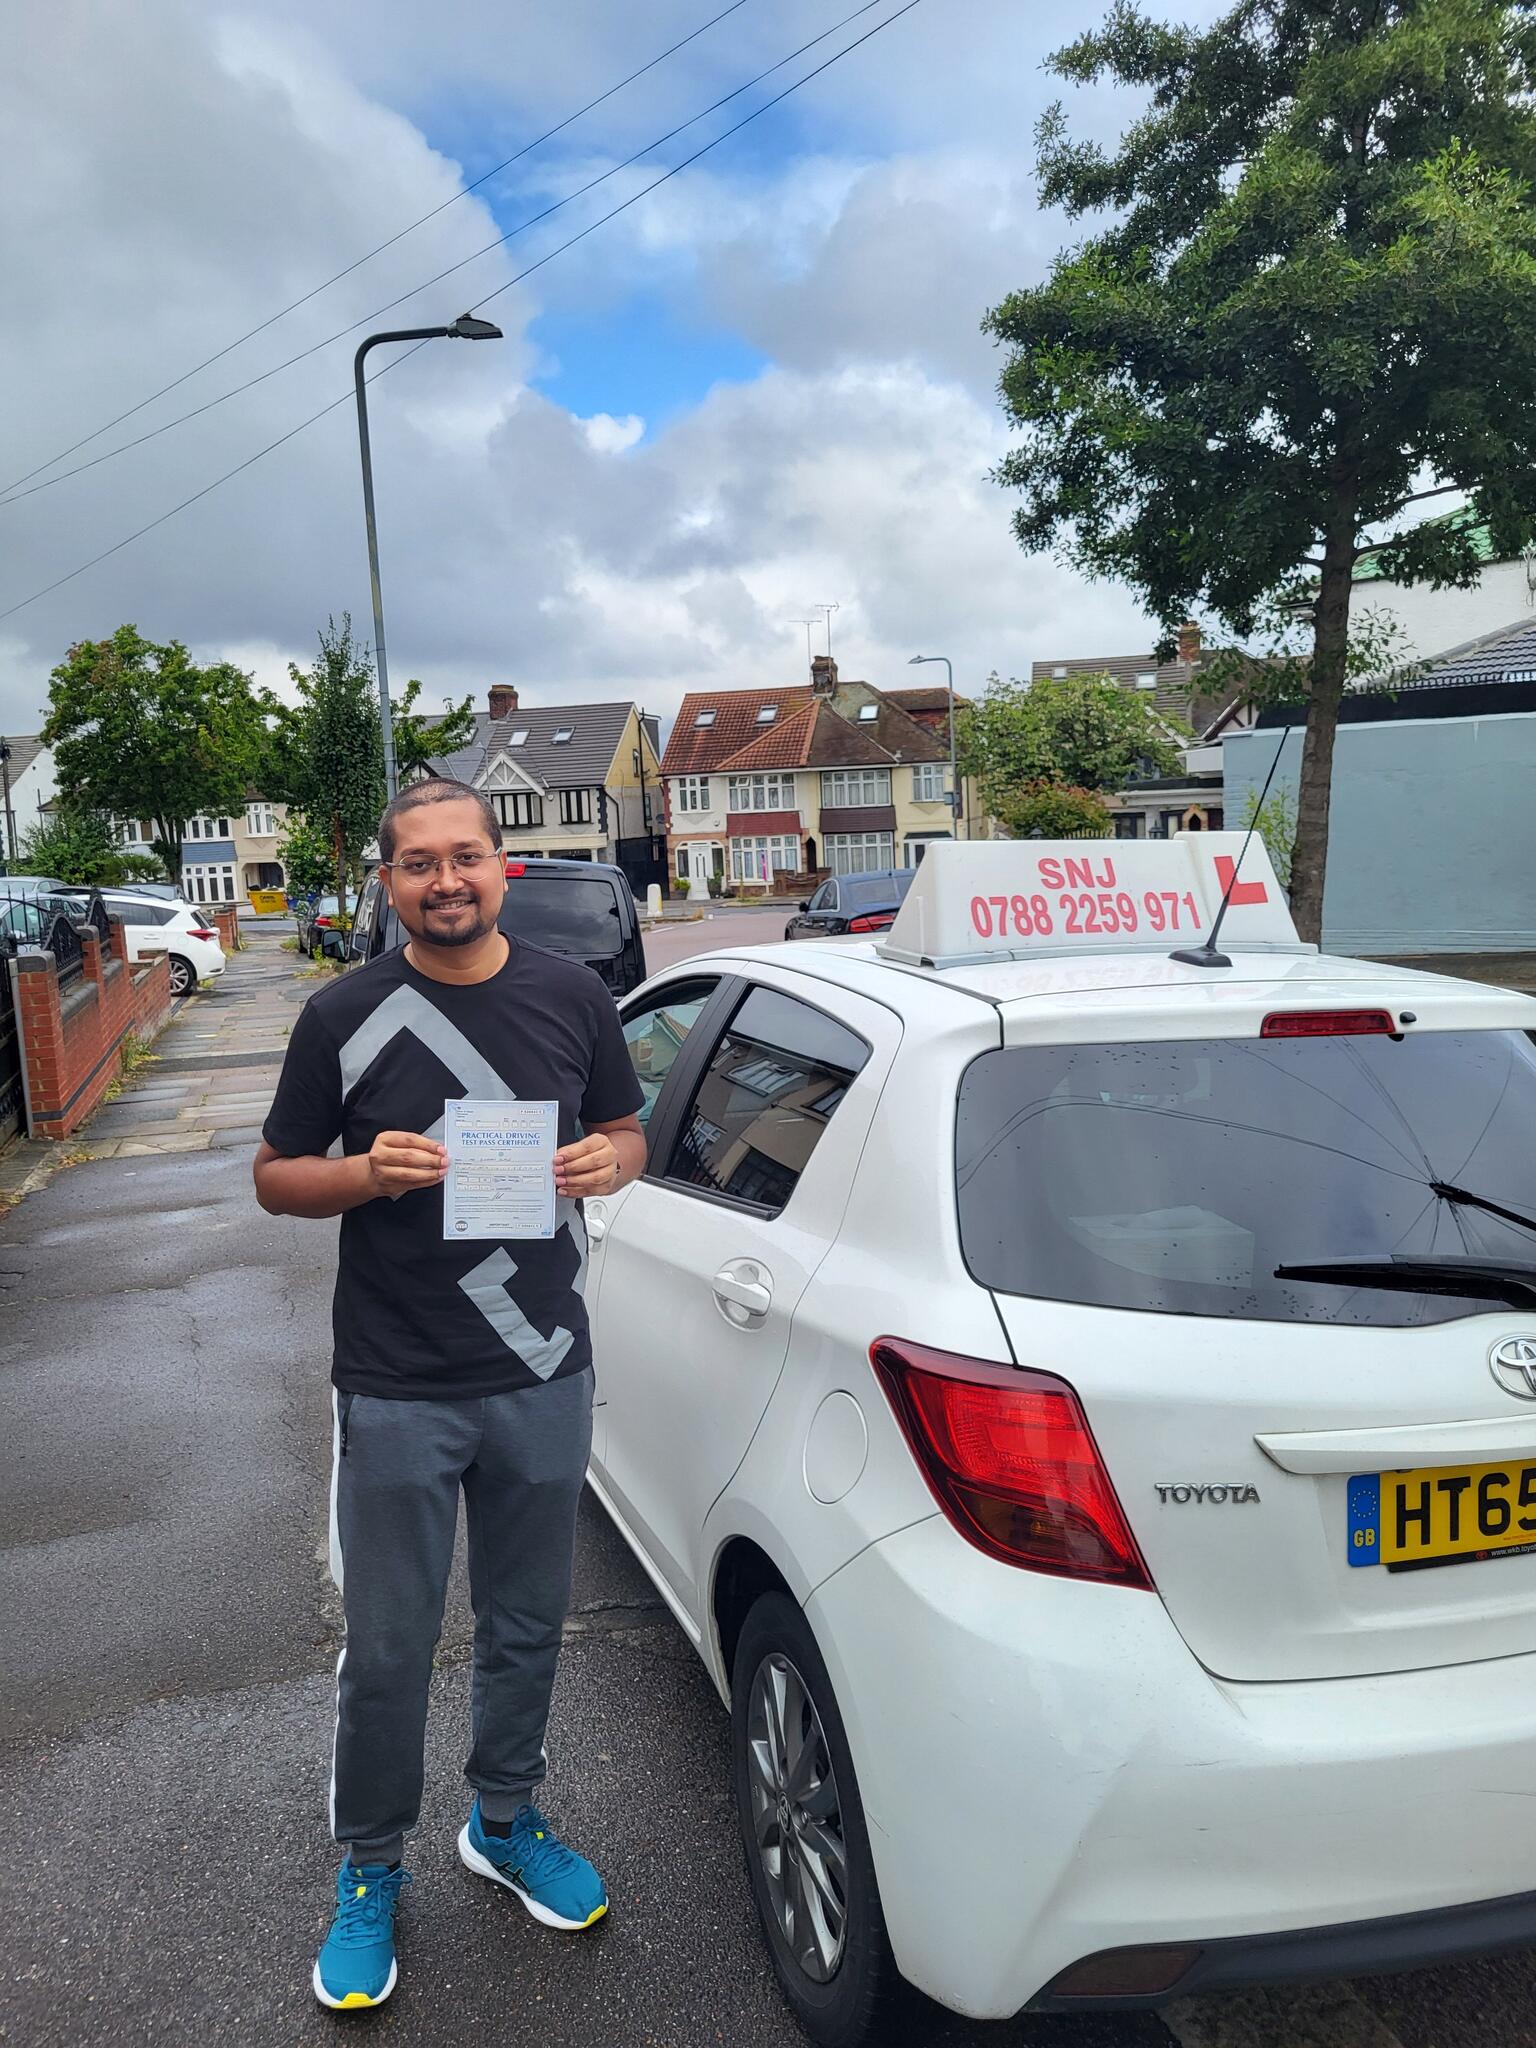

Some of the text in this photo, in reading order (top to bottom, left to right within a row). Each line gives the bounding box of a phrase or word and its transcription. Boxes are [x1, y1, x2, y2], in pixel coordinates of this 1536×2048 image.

[1037, 857, 1117, 890] SNJ
[1213, 855, 1269, 906] L
[970, 890, 1201, 938] 0788 2259 971
[1154, 1482, 1261, 1505] TOYOTA
[1395, 1468, 1536, 1549] HT65
[1353, 1528, 1376, 1548] GB
